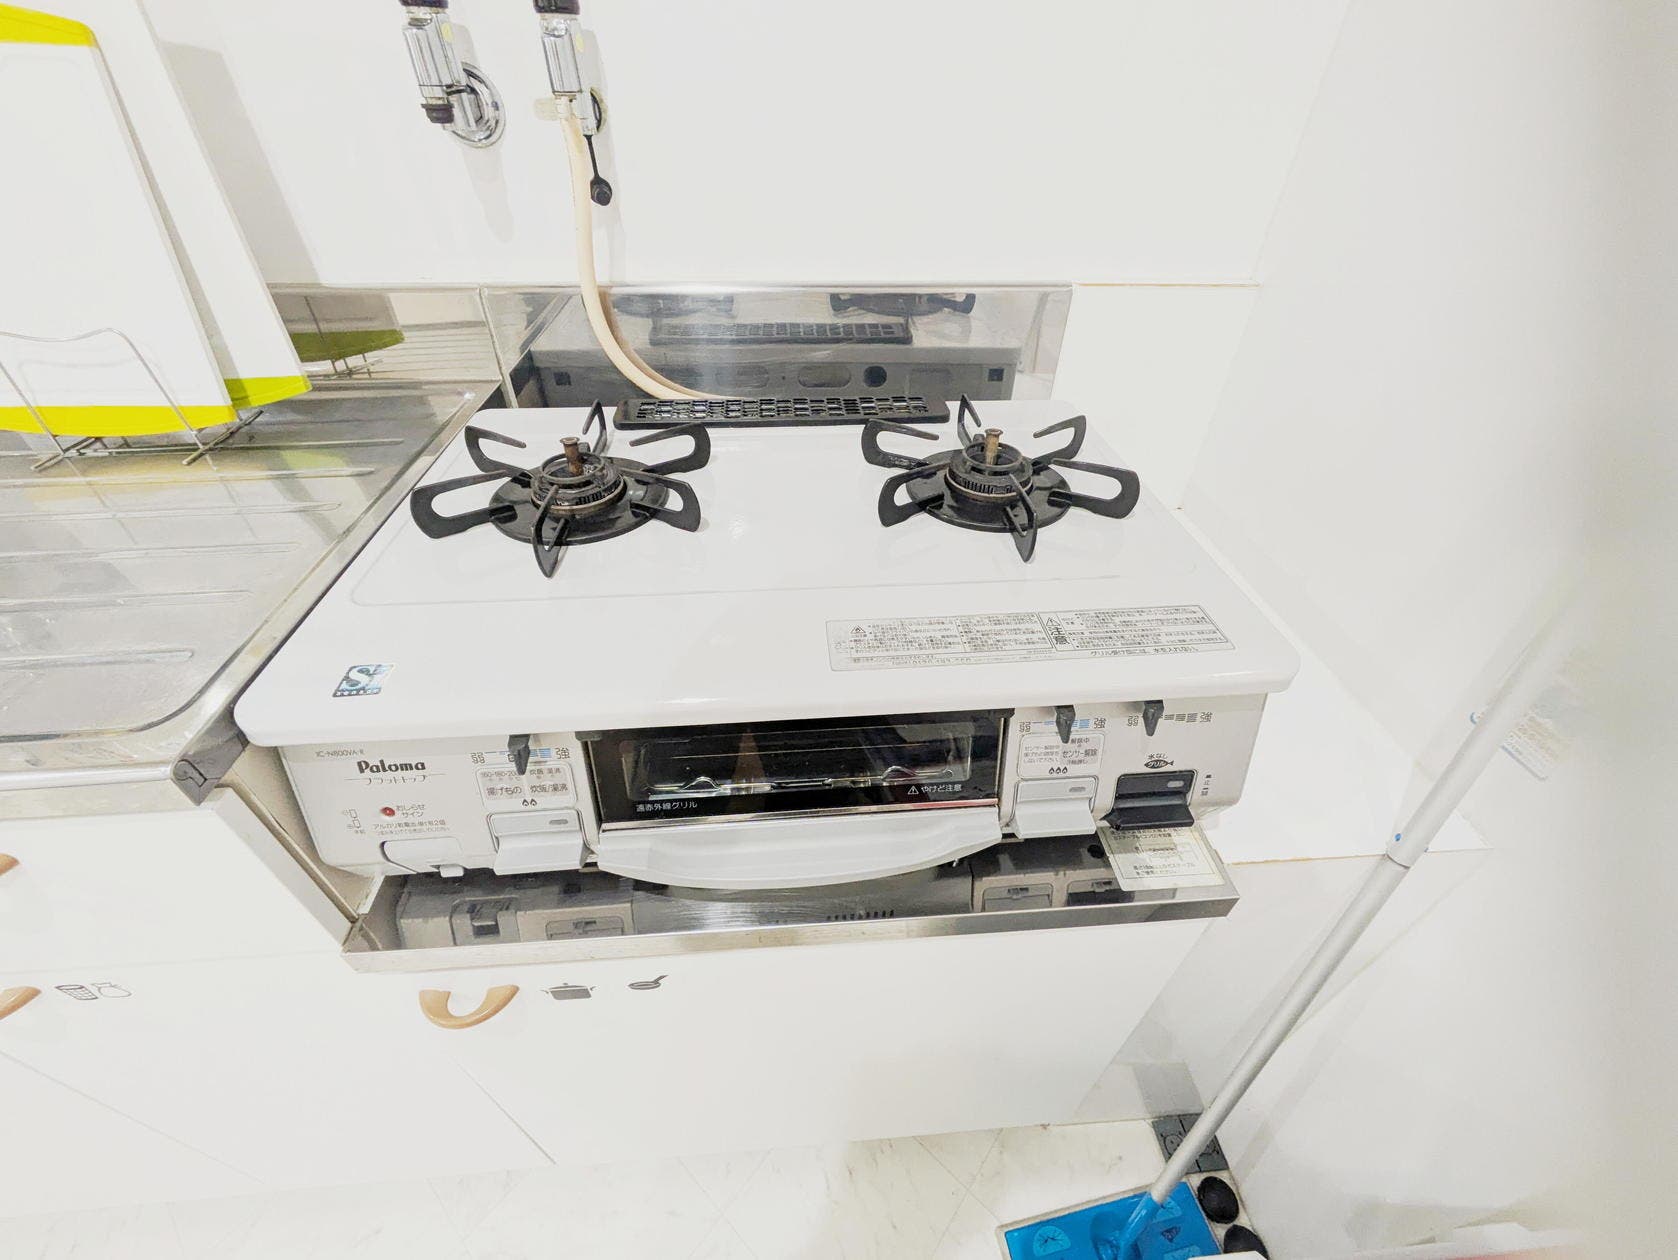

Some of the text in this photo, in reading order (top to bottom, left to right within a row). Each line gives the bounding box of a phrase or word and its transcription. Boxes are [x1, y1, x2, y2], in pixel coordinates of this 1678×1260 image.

[1093, 717, 1107, 729] 強
[471, 752, 486, 764] 弱
[554, 747, 571, 760] 強
[356, 759, 427, 774] Paloma
[486, 785, 522, 796] 揚げもの
[921, 783, 962, 793] やけど注意
[635, 801, 698, 812] 遠赤外線グリル
[402, 810, 425, 818] サイン
